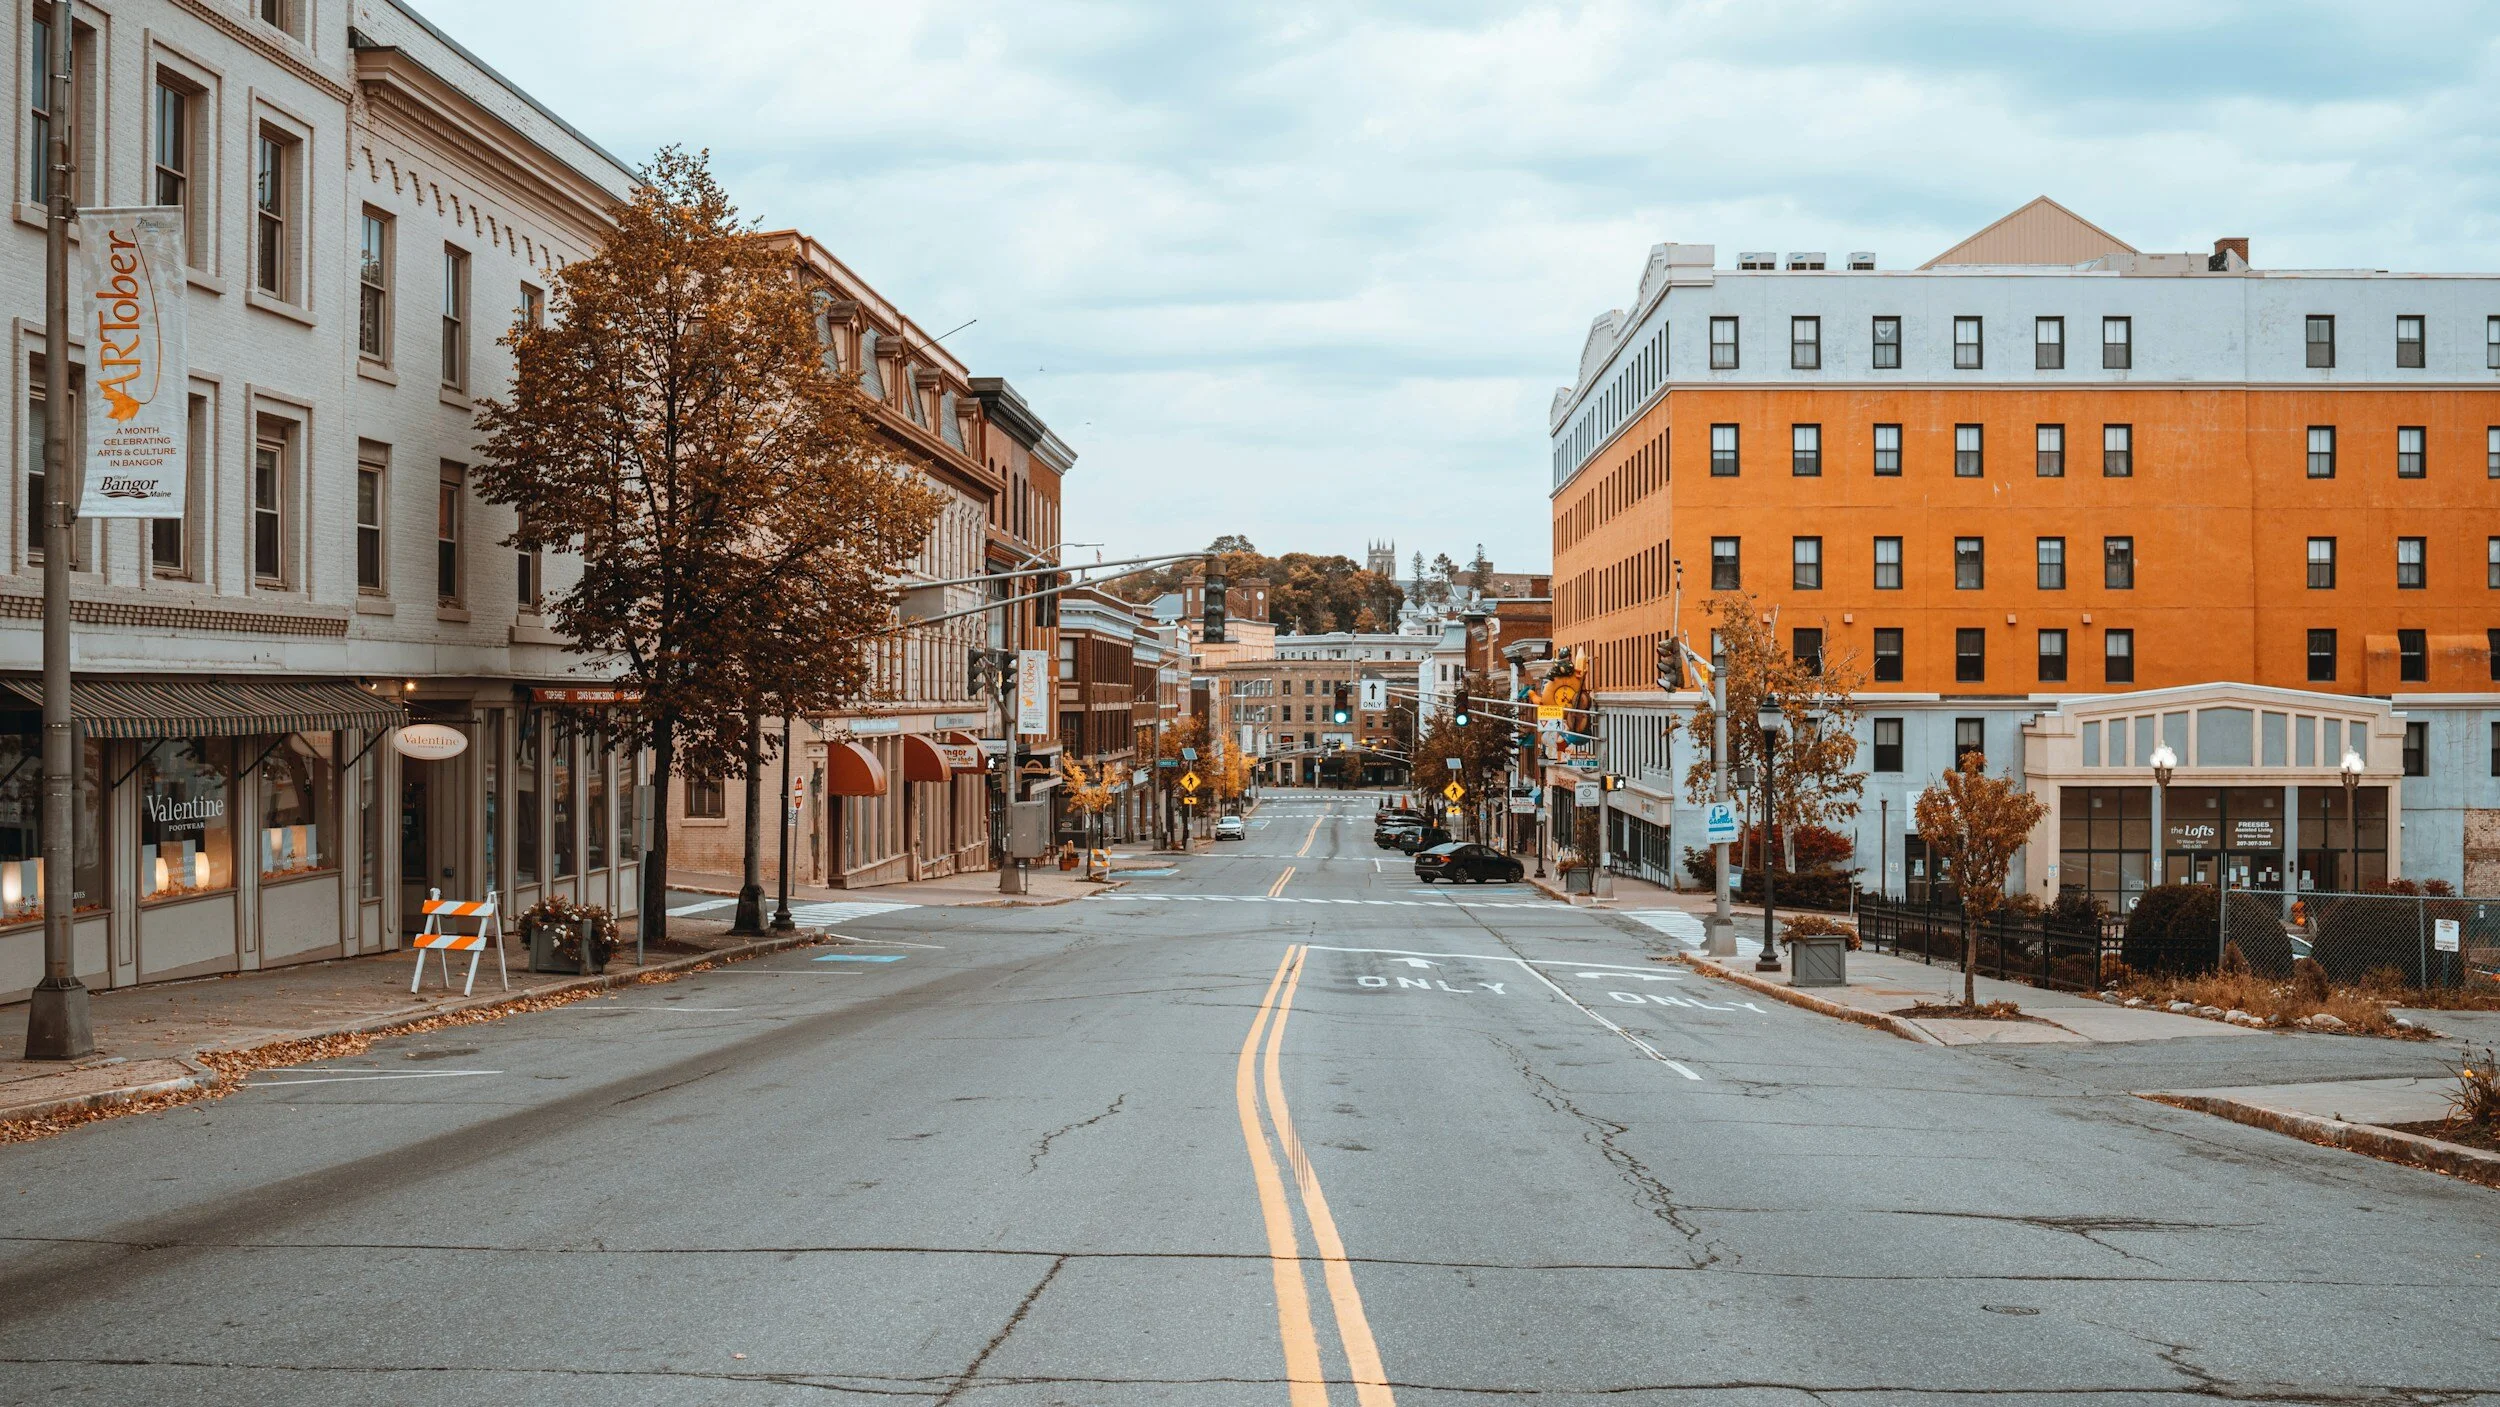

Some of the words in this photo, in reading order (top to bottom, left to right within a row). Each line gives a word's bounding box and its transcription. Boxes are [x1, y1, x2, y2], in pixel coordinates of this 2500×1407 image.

[96, 228, 142, 410] ARTober
[125, 427, 159, 435] MONTH
[104, 437, 171, 446] CELEBRATING
[97, 449, 122, 457] ARTS
[132, 447, 176, 456] CULTURE
[122, 459, 163, 467] BANGOR
[100, 476, 158, 494] Bangor
[403, 733, 460, 746] Valentine
[943, 749, 967, 757] angor
[147, 794, 224, 823] Valentine
[1708, 817, 1733, 825] GARAGE
[168, 822, 205, 832] FOOTWEAR
[2170, 826, 2183, 834] the
[2185, 825, 2215, 838] Lofts
[1357, 975, 1506, 995] ONLY
[1607, 991, 1768, 1013] ONLY
